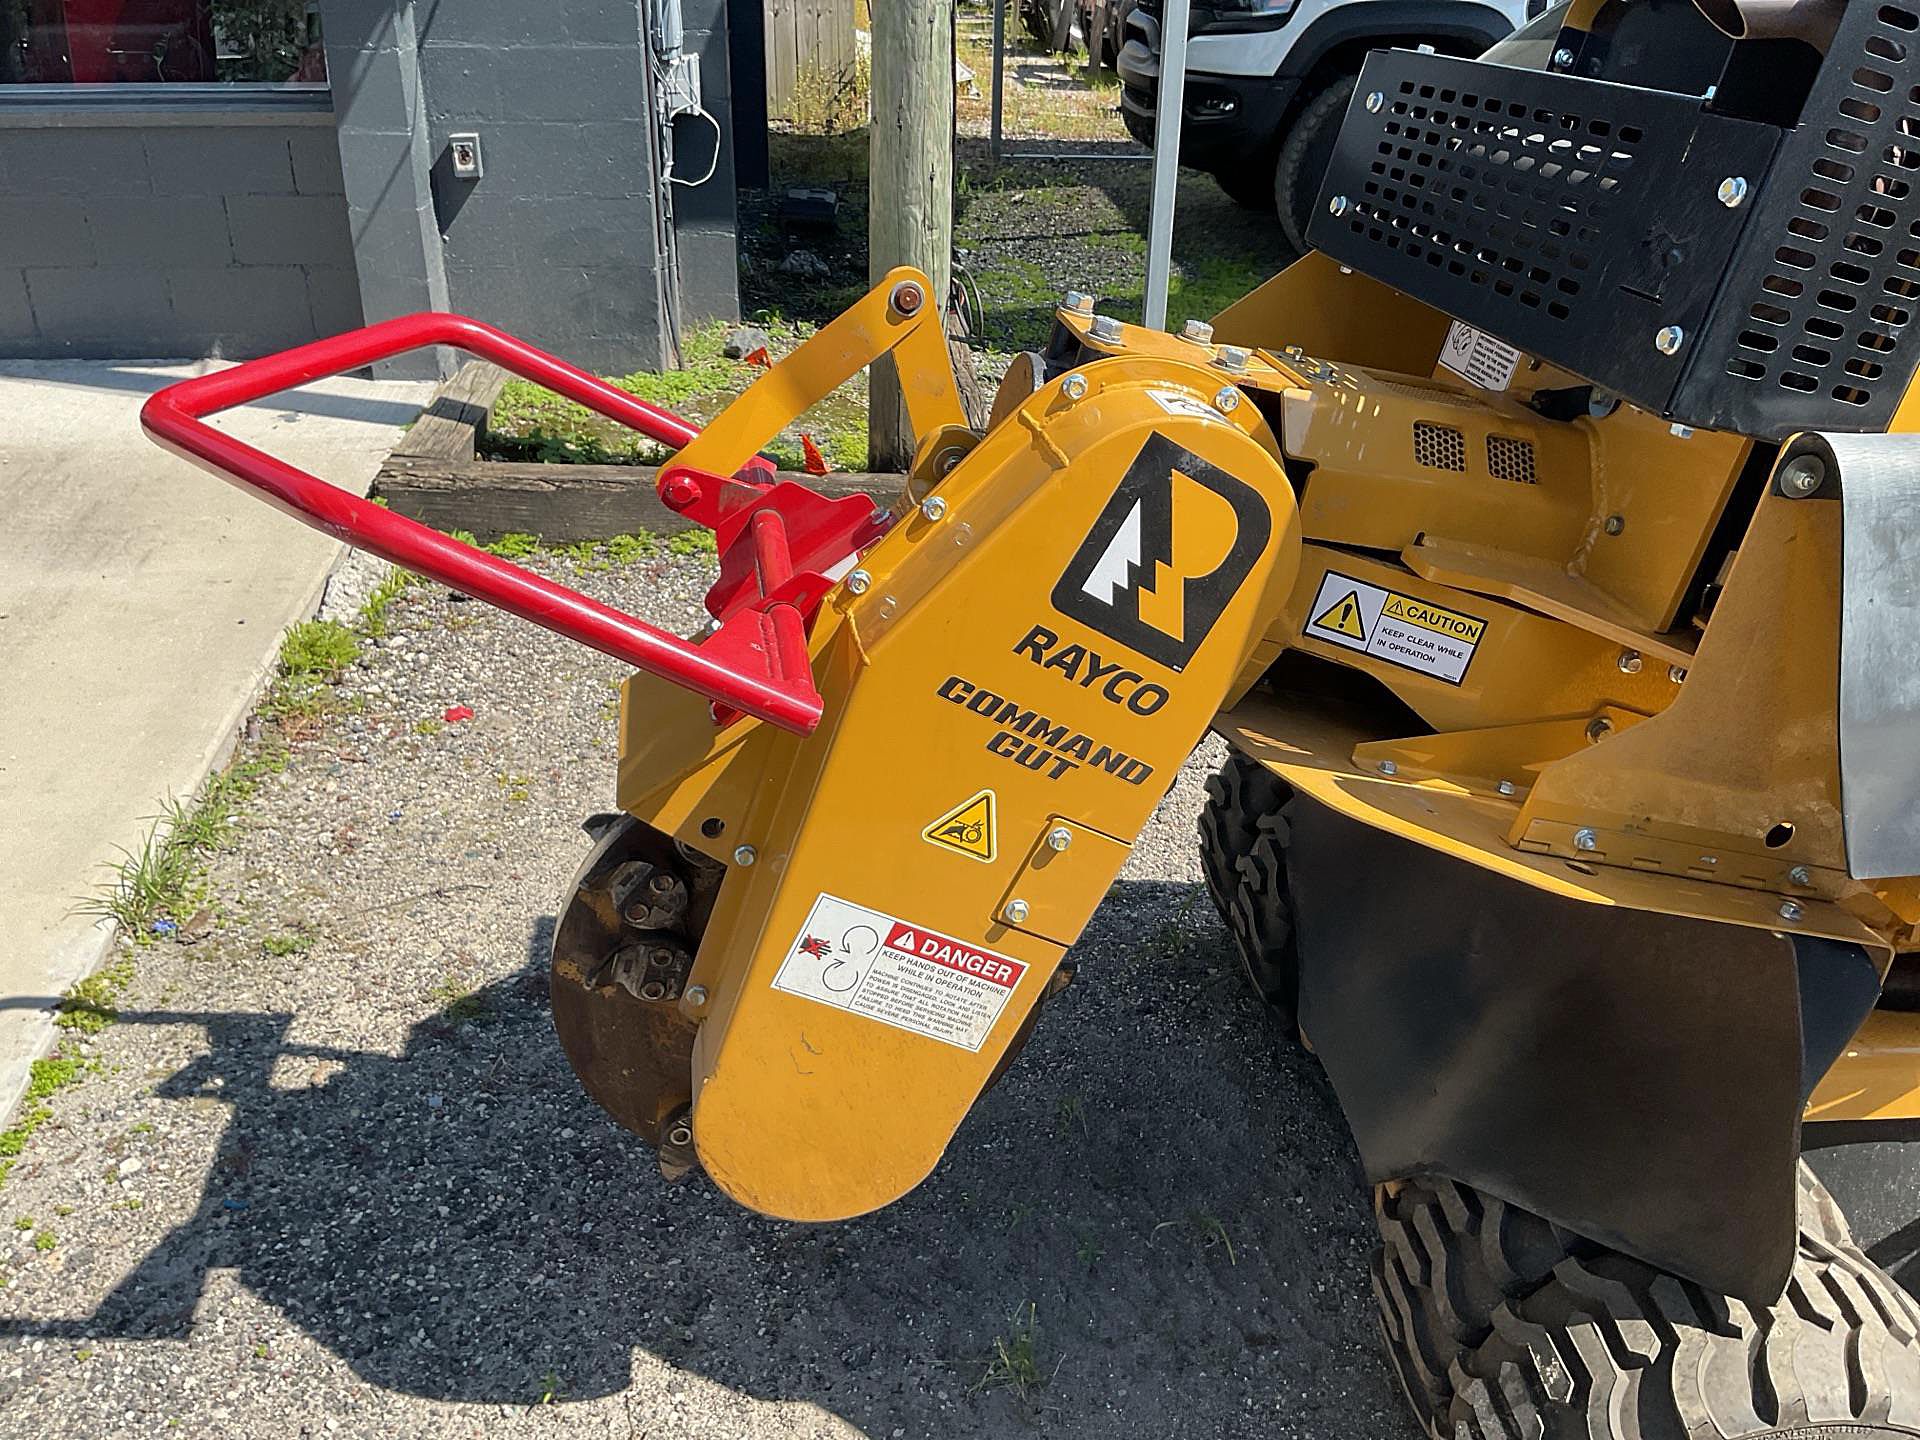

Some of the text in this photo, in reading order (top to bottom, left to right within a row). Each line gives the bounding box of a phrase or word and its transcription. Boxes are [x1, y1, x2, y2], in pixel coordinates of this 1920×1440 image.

[1406, 606, 1477, 637] CAUTION
[1377, 638, 1435, 662] IN OPERATION
[1381, 627, 1462, 658] KEEP CLEAR WHILE
[1012, 624, 1170, 717] RAYCO
[936, 676, 1154, 786] COMMAND
[986, 731, 1080, 780] CUT
[882, 950, 1006, 995] KEEP HANDS OUT OF MACHINE
[919, 939, 1013, 981] DANGER
[869, 975, 891, 986] POWER
[940, 998, 956, 1007] LOOK
[958, 1004, 971, 1012] AND
[972, 1008, 992, 1019] LISTEN
[872, 969, 898, 980] MACHINE
[900, 978, 932, 991] CONTINUES
[945, 992, 967, 1003] ROTATE
[969, 1000, 988, 1010] AFTER
[896, 965, 982, 997] WHILE IN OPERATION
[854, 1000, 875, 1010] CAUSE
[876, 1007, 900, 1018] SEVERE
[901, 1016, 931, 1027] PERSONAL
[858, 994, 883, 1005] FAILURE
[895, 1005, 911, 1014] HEED
[912, 1011, 926, 1019] THIS
[927, 1017, 953, 1028] WARNING
[955, 1025, 969, 1033] MAY
[862, 988, 888, 999] STOPPED
[890, 997, 914, 1007] BEFORE
[915, 1006, 945, 1017] SERVICING
[876, 985, 898, 995] ASSURE
[901, 992, 916, 1001] THAT
[918, 998, 930, 1006] ALL
[931, 1003, 959, 1014] ROTATION
[961, 1012, 974, 1020] HAS
